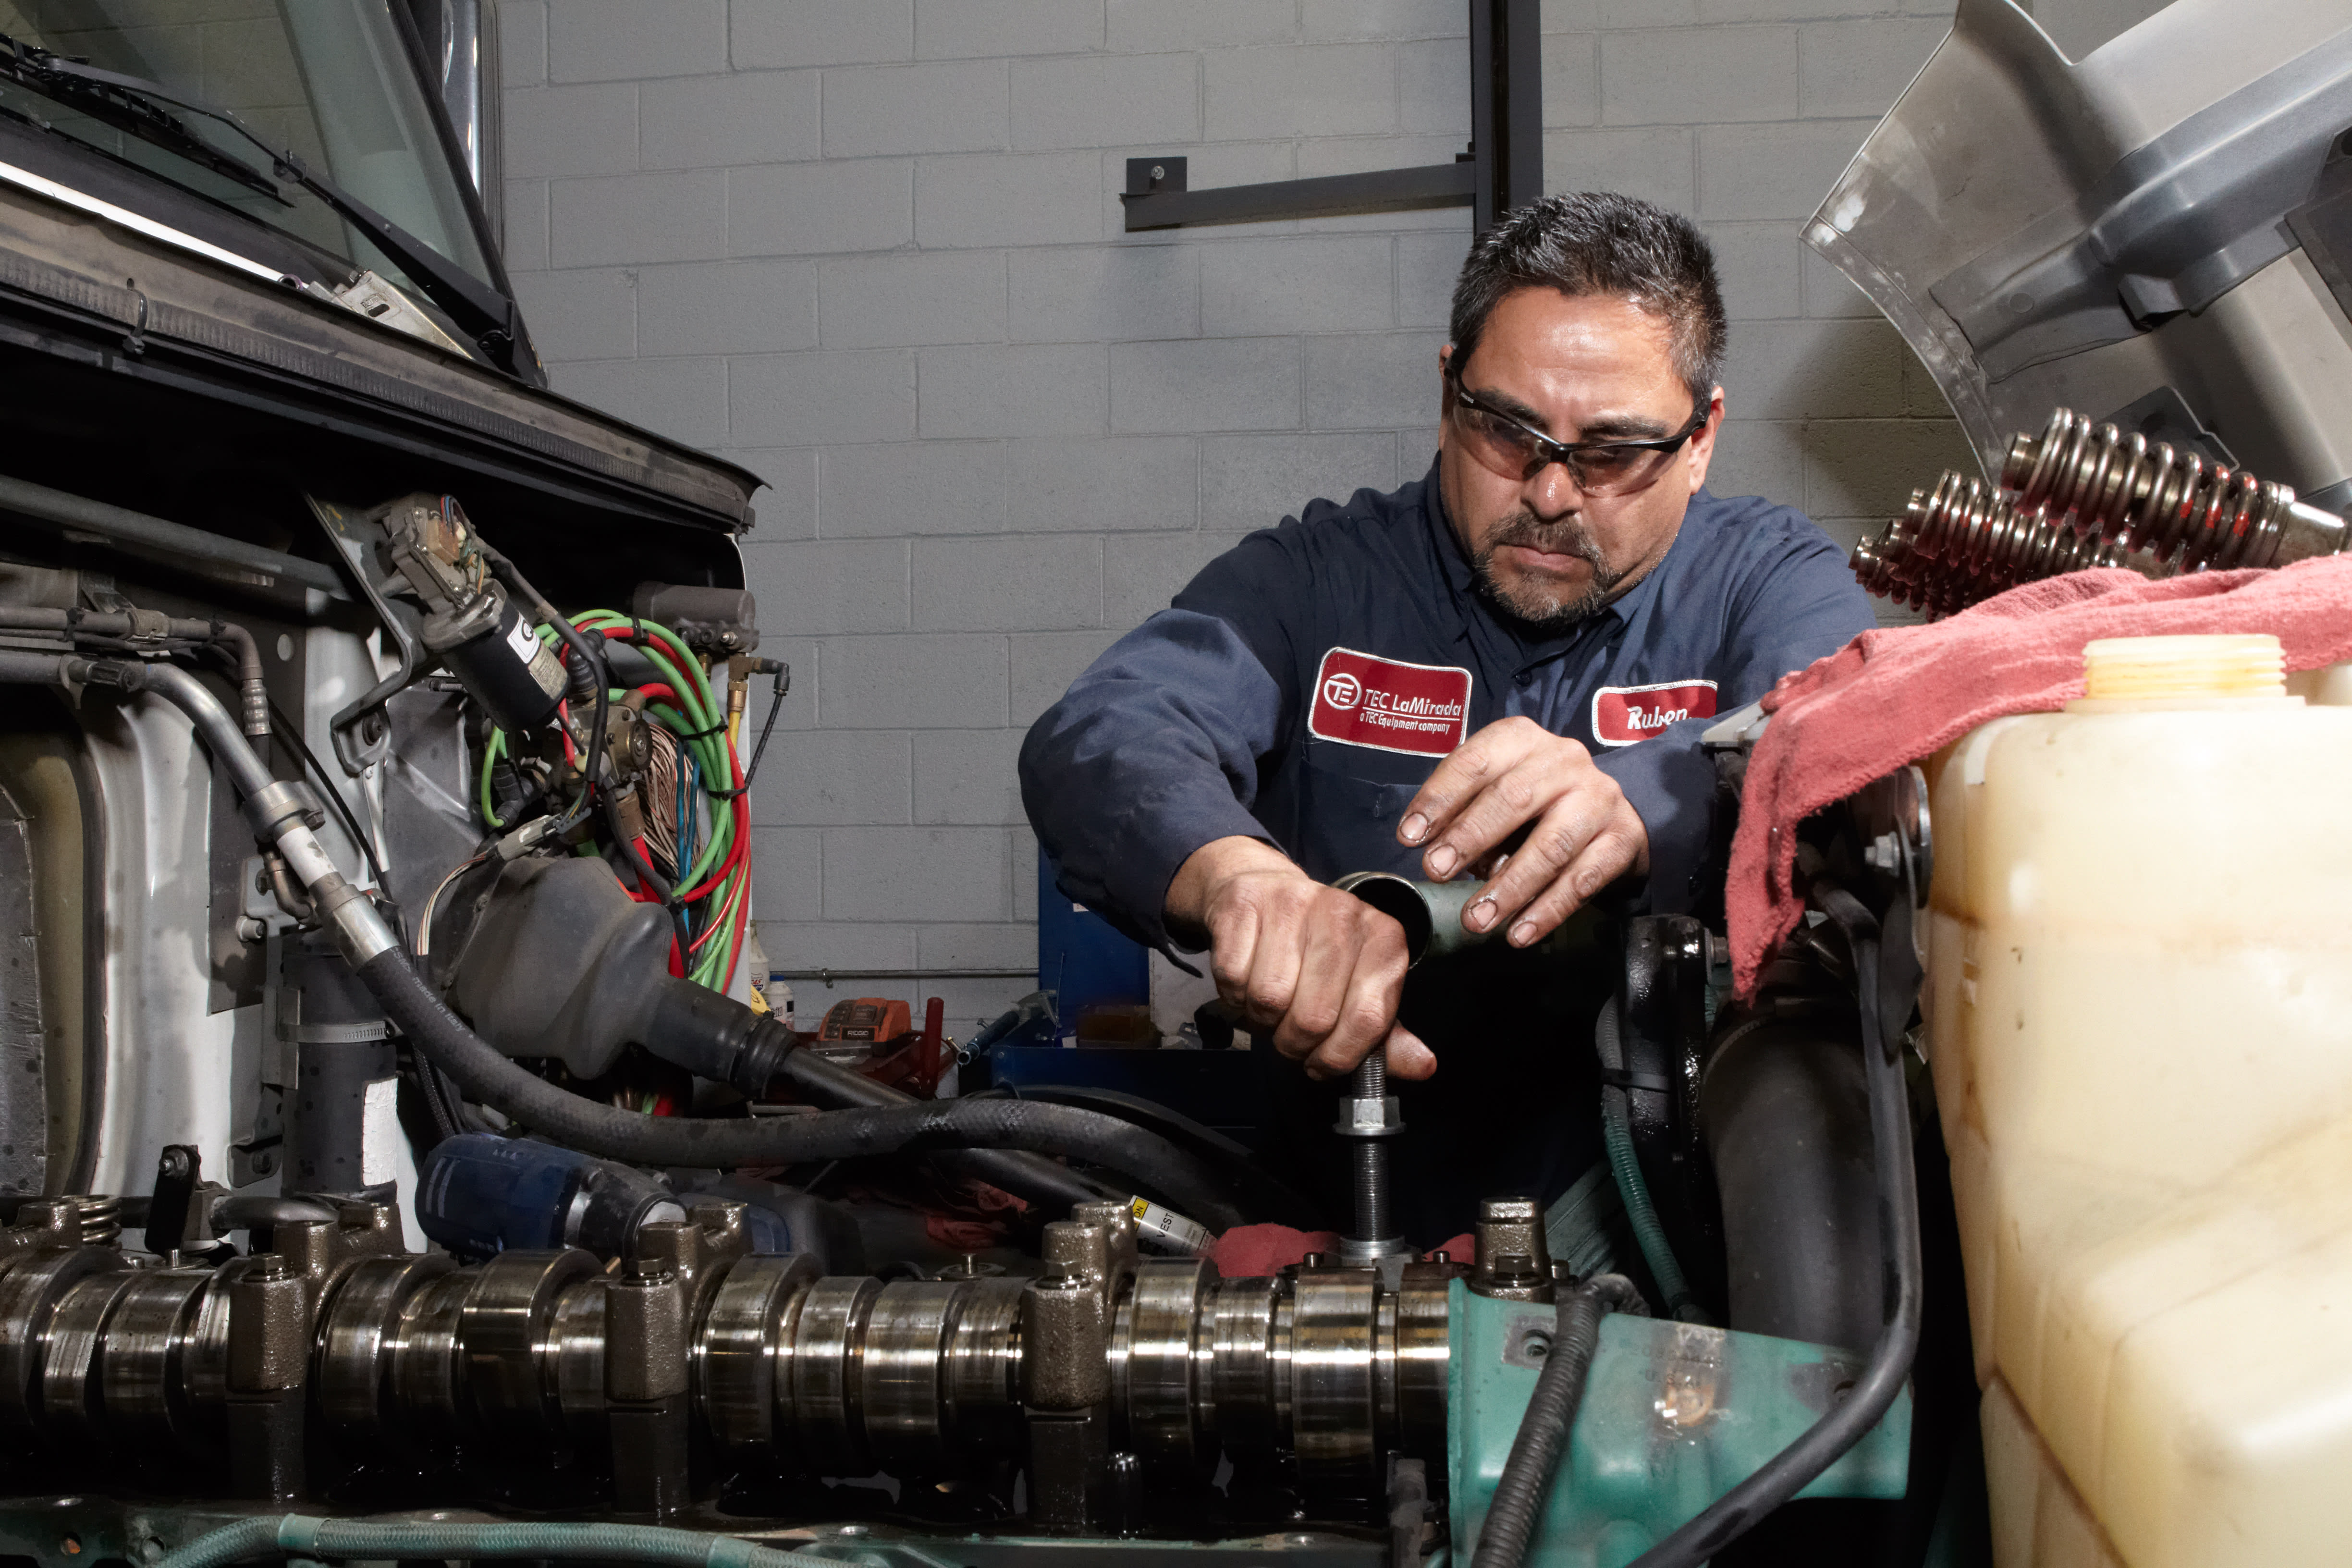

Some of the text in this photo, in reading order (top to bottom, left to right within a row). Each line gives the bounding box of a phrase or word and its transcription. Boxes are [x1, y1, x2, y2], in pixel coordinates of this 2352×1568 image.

[1364, 688, 1462, 717] TEC LaMirada
[1360, 711, 1450, 735] a TEC Equipment company
[1627, 706, 1688, 730] Ruben
[412, 977, 436, 1003] made
[434, 1003, 446, 1014] in
[1134, 1205, 1144, 1218] ON
[1156, 1213, 1174, 1238] VEST
